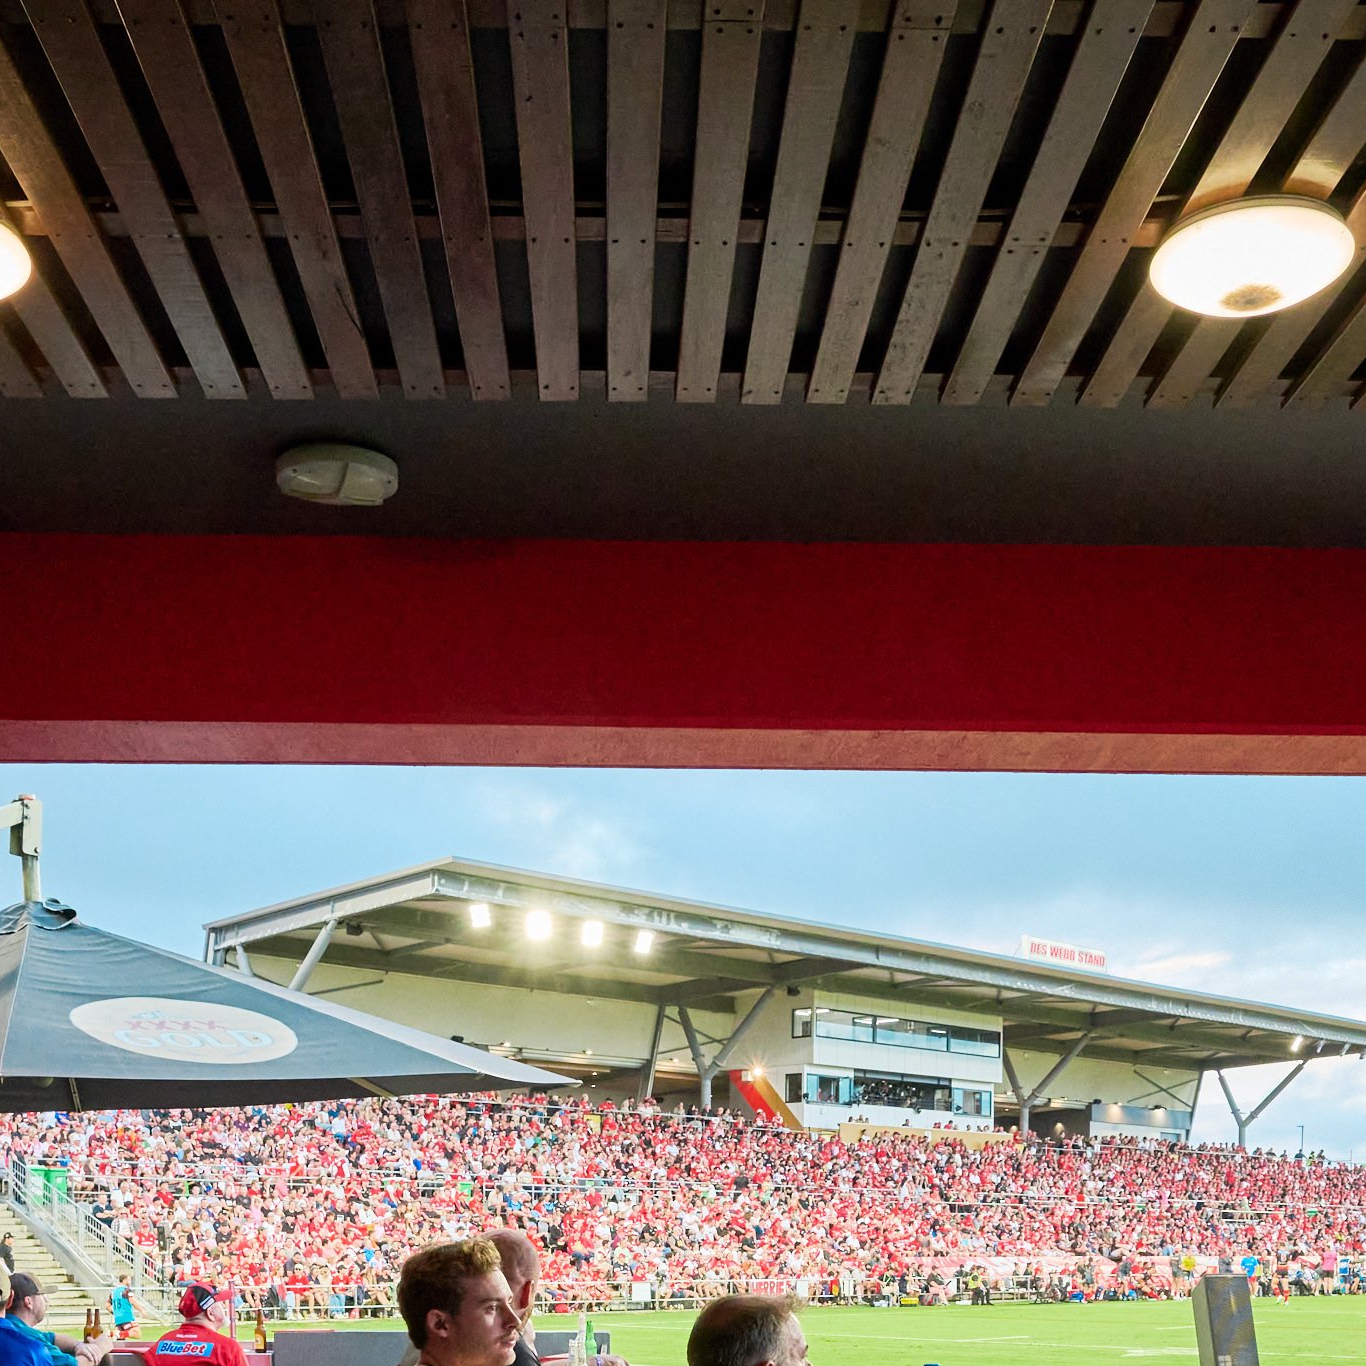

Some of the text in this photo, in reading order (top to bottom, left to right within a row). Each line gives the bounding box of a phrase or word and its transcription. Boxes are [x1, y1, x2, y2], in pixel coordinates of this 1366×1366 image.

[1030, 942, 1047, 954] DES
[1078, 951, 1105, 966] STAND
[113, 1028, 275, 1050] GOLD
[160, 1343, 206, 1354] BlueBet
